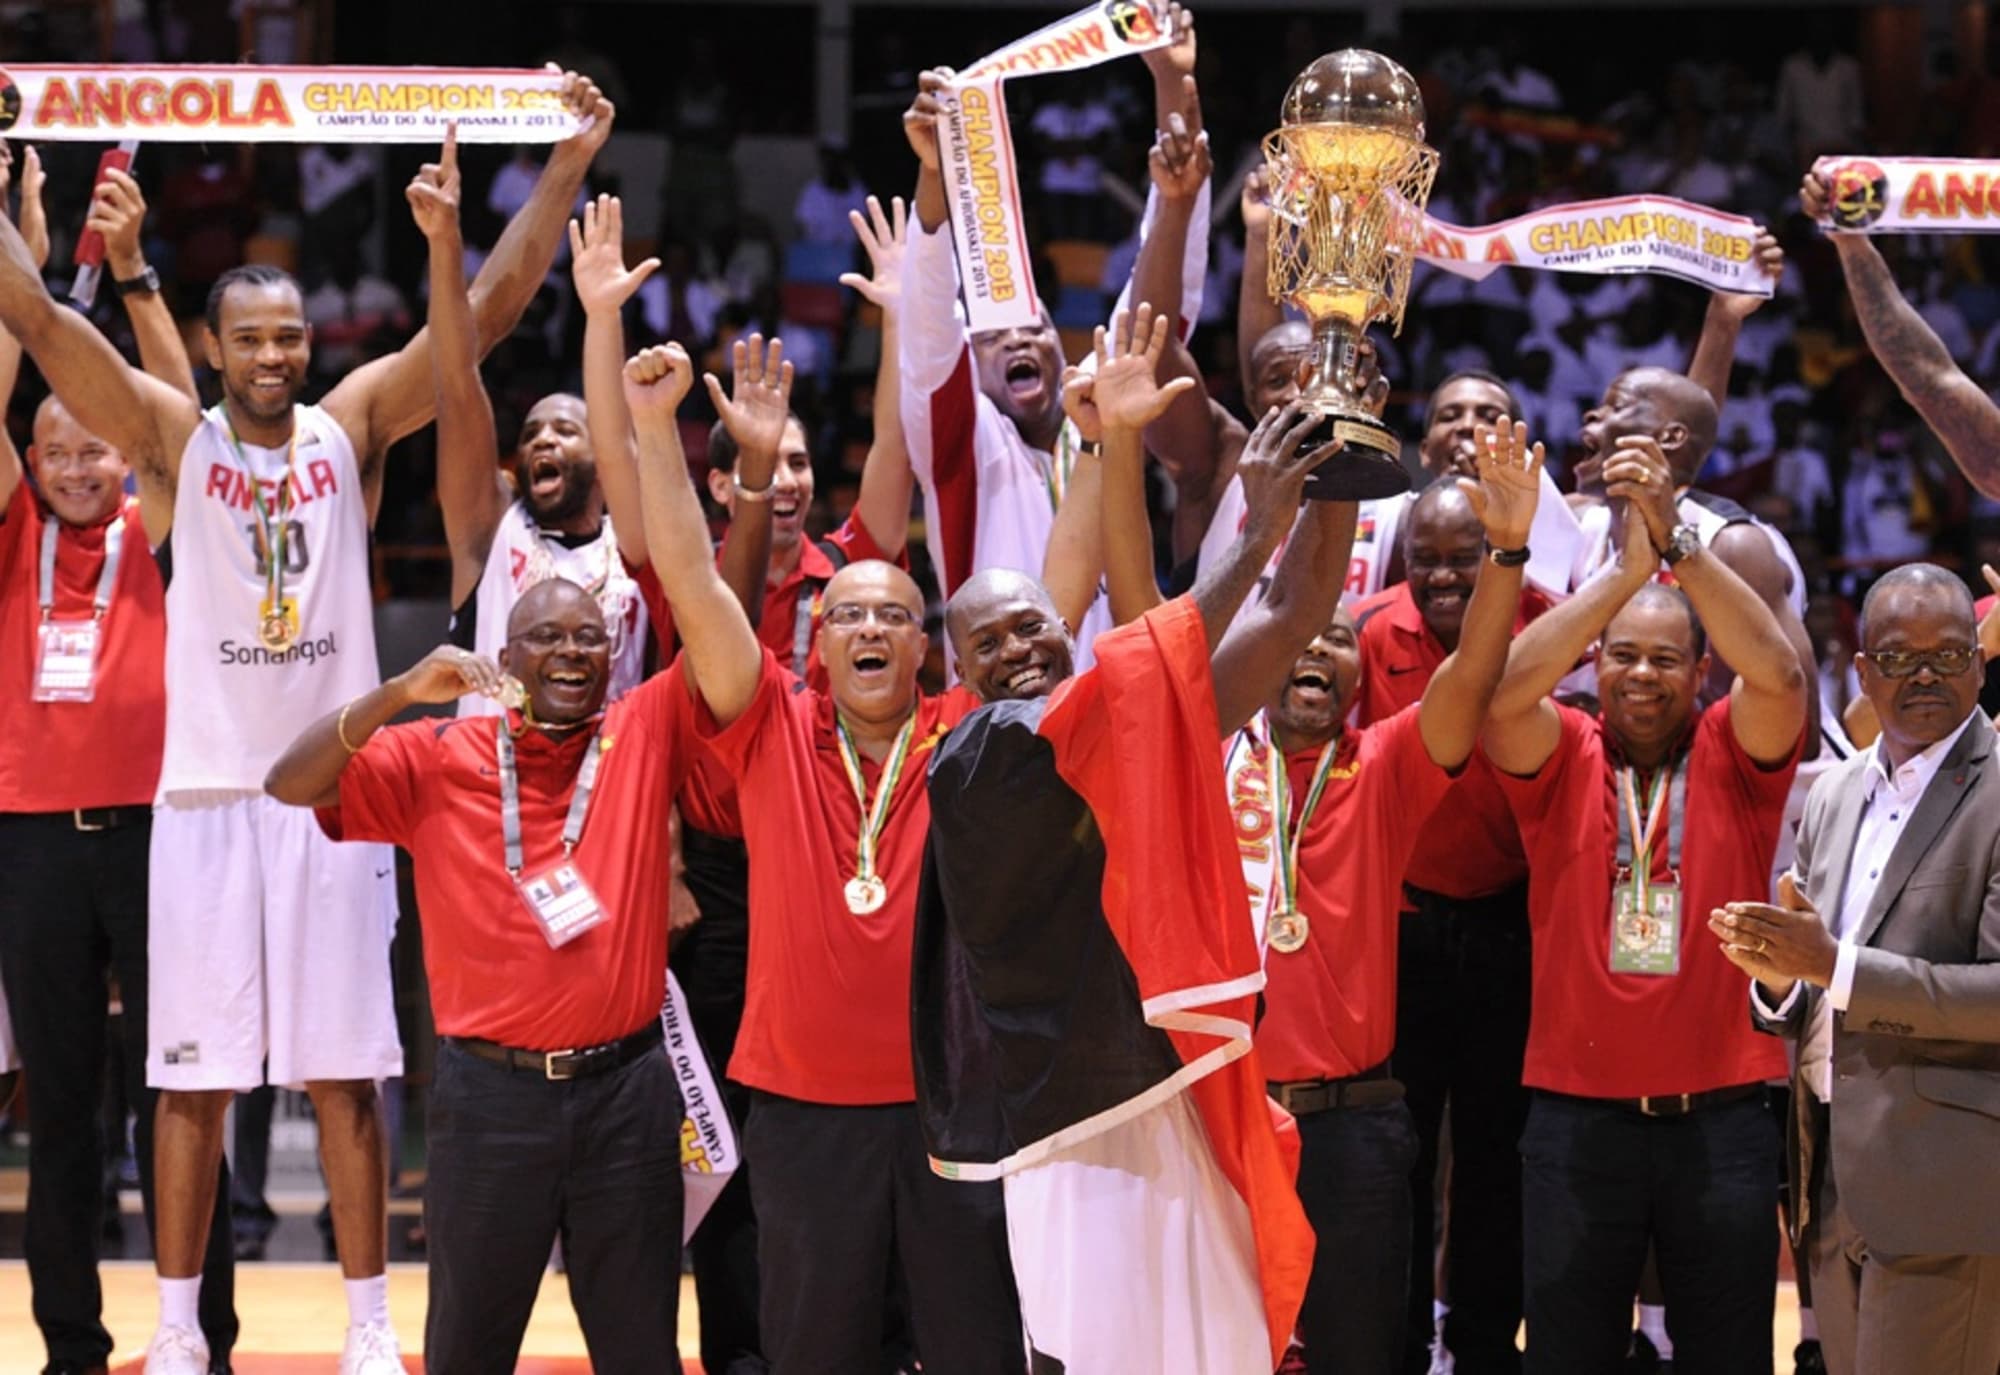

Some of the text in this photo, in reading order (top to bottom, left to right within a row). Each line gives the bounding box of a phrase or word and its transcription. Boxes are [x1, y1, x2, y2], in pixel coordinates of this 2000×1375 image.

[35, 78, 294, 128] ANGOLA
[303, 83, 495, 112] CHAMPION
[317, 113, 389, 126] CAMPEÃO
[395, 115, 417, 126] DO
[955, 167, 969, 185] DO
[960, 86, 1016, 303] CHAMPION 2013
[1529, 212, 1698, 254] CHAMPION
[1702, 227, 1752, 262] 2013
[1620, 244, 1643, 256] DO
[220, 632, 337, 666] Sonangol
[676, 1055, 696, 1081] DO
